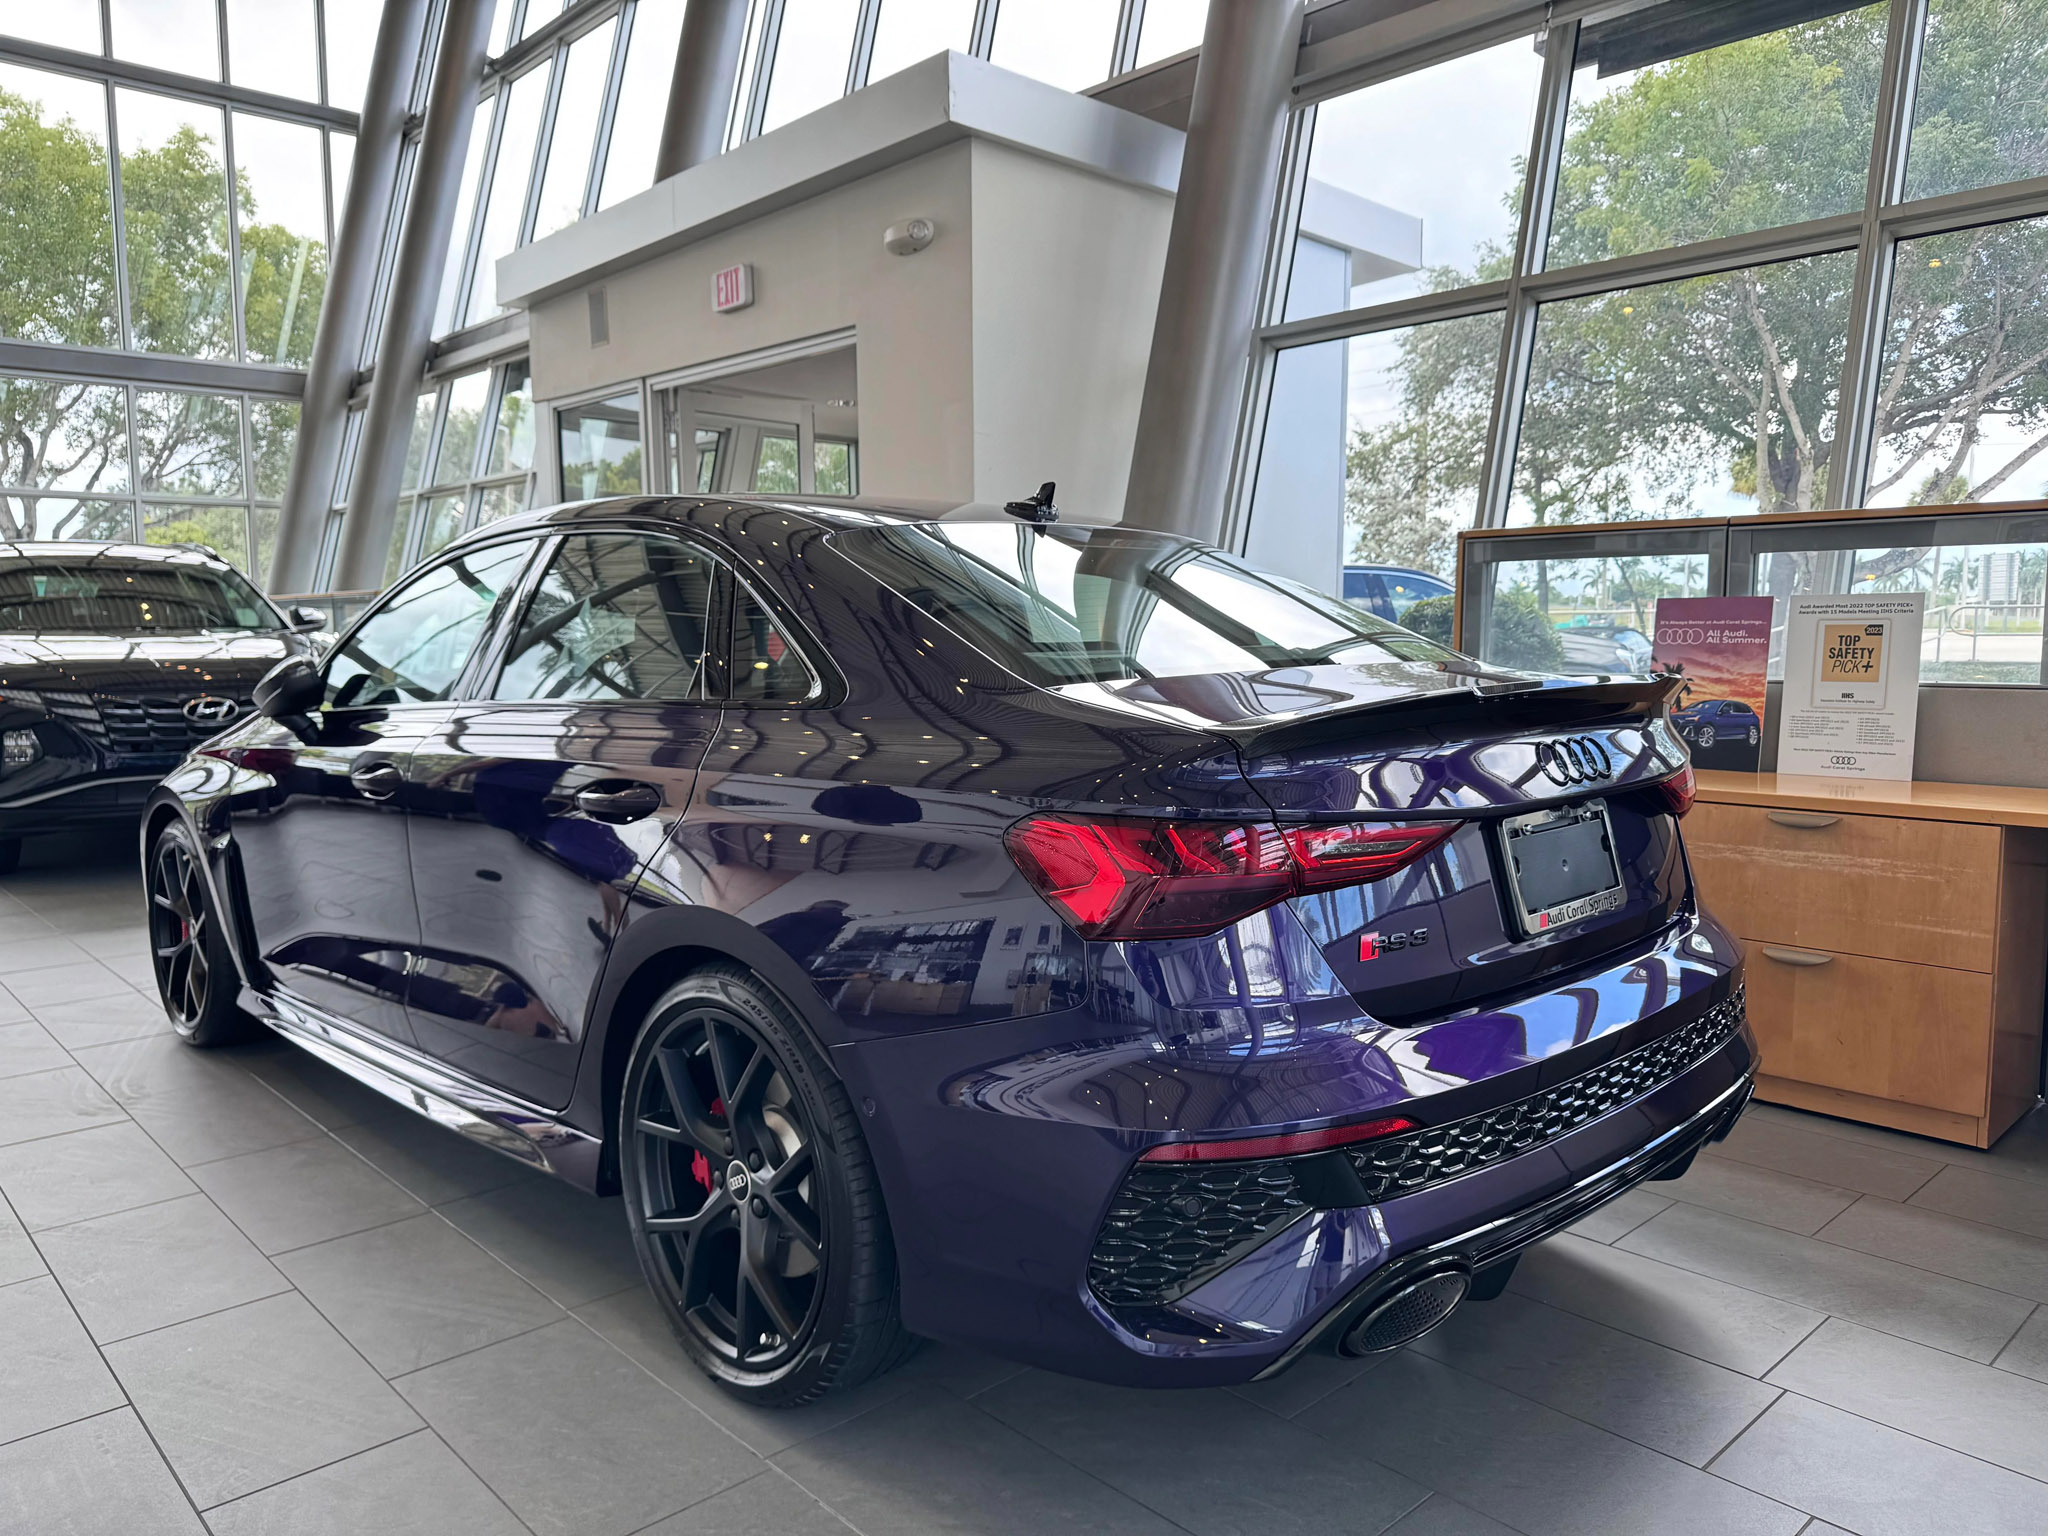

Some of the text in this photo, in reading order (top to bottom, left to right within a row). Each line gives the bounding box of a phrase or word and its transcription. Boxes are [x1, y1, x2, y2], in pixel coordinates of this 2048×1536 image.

[716, 266, 740, 307] EXIT
[1706, 629, 1748, 637] All Audi.
[1838, 635, 1861, 647] TOP
[1828, 647, 1875, 659] SAFETY
[1831, 660, 1874, 673] PICK+
[1547, 893, 1618, 926] Audi Coral Springs
[742, 998, 779, 1036] 245/35
